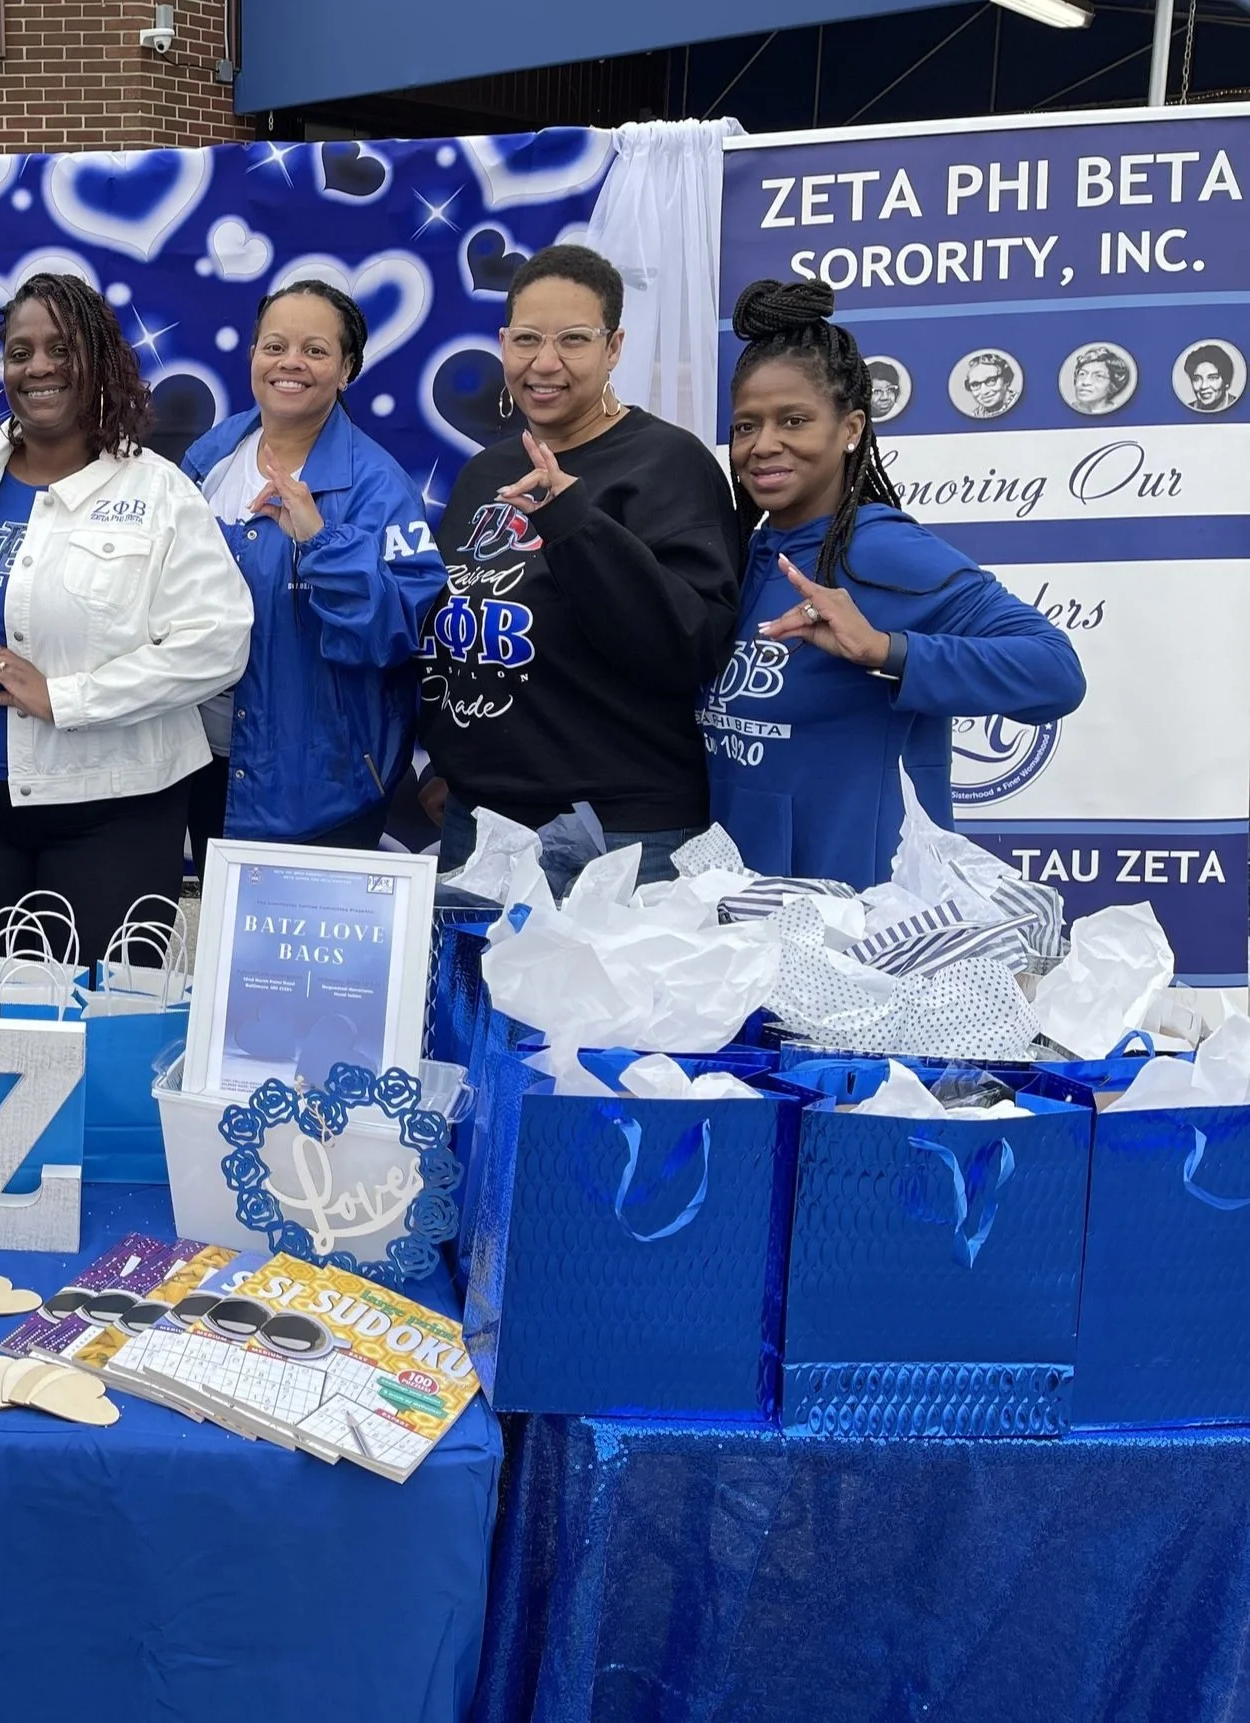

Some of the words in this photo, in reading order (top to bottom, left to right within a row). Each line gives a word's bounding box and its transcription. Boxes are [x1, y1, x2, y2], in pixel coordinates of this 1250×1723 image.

[760, 168, 922, 228] ZETA
[947, 159, 1049, 215] PHI
[1076, 149, 1243, 208] BETA
[790, 235, 1074, 290] SORORITY,
[1100, 228, 1206, 274] INC.
[882, 449, 1047, 518] onoring
[1069, 441, 1182, 505] Our
[735, 719, 782, 736] BETA
[952, 788, 994, 800] Sisterhood
[1002, 776, 1022, 791] Finer
[1019, 734, 1050, 778] Womanhood
[1012, 850, 1099, 884] TAU
[1116, 849, 1226, 884] ZETA
[244, 914, 306, 937] BATZ
[319, 920, 386, 944] LOVE
[278, 944, 344, 965] BAGS
[310, 1289, 474, 1378] SUDOKU
[409, 1371, 433, 1387] 100
